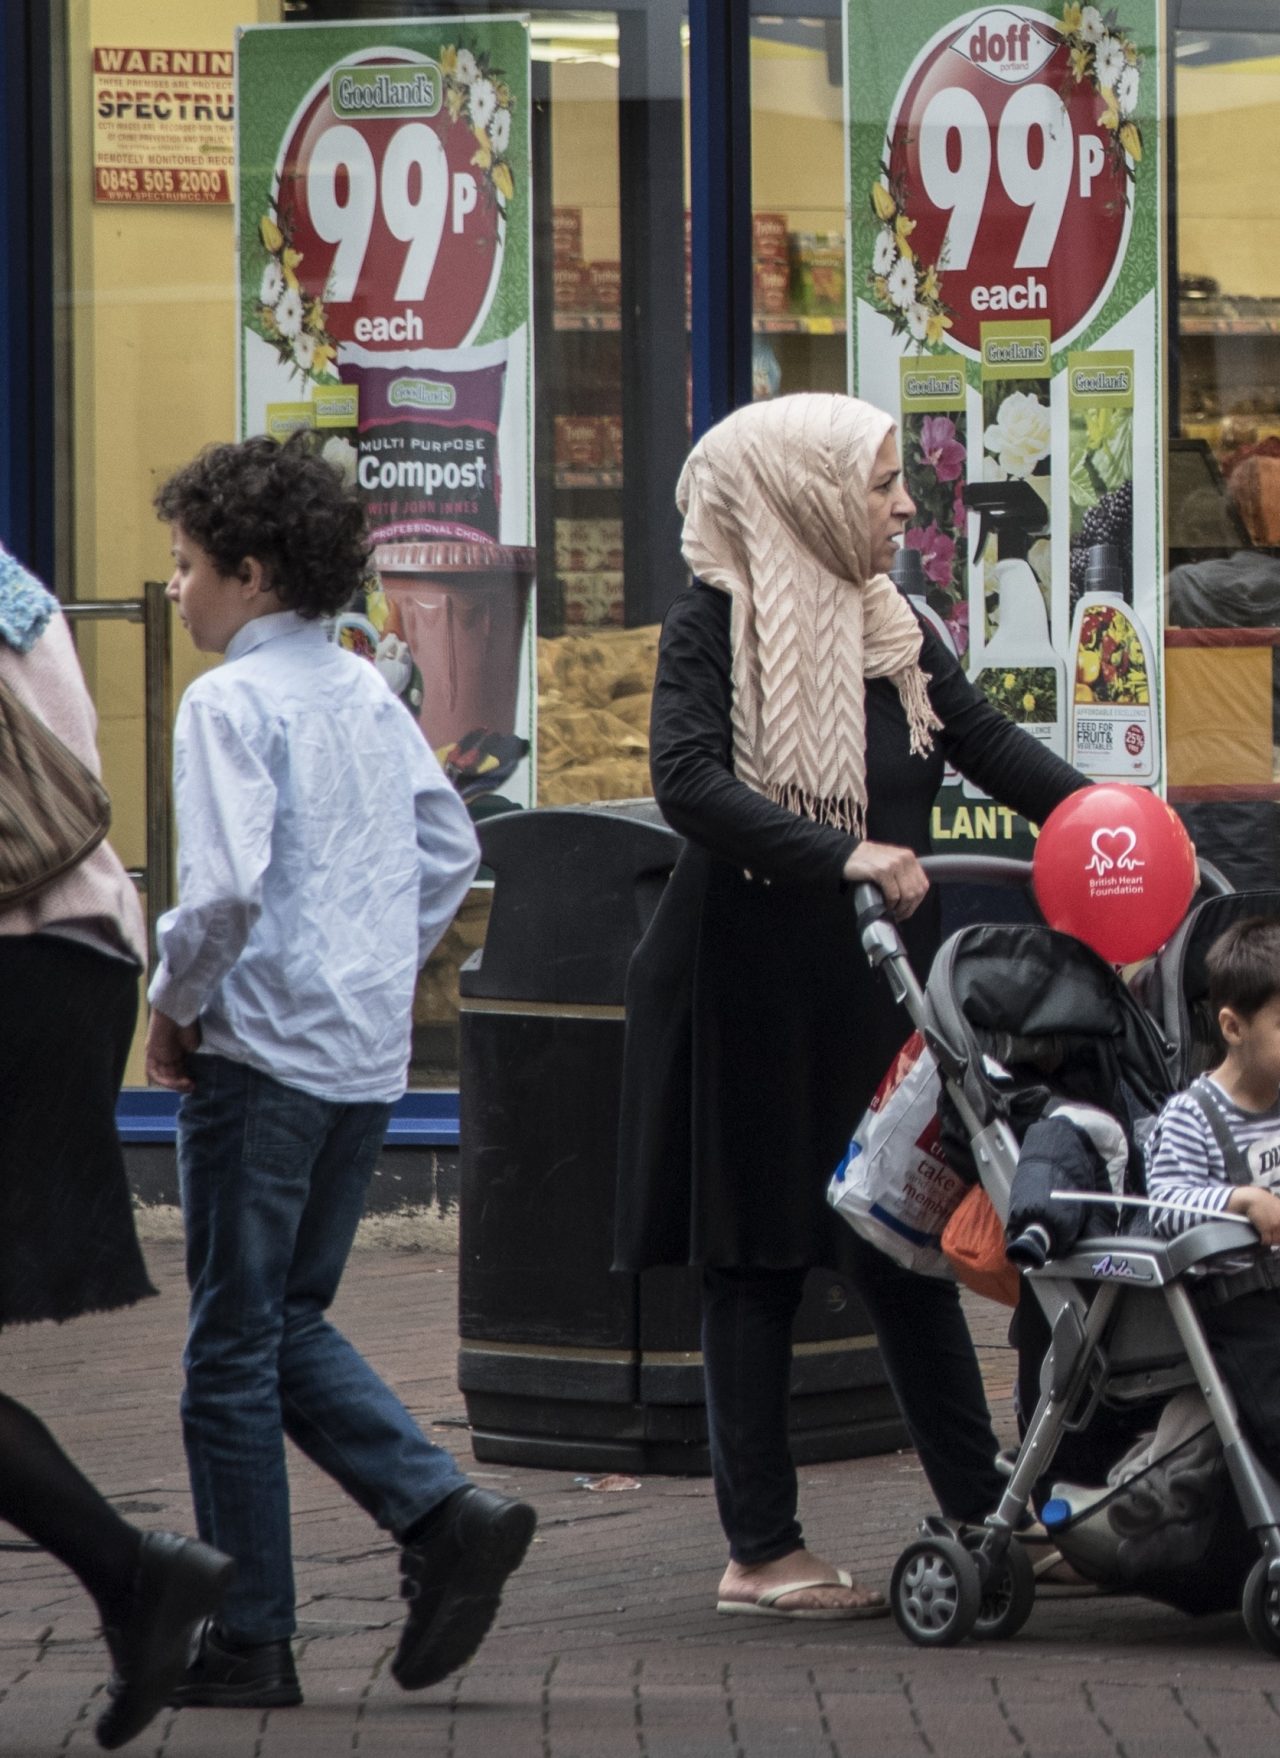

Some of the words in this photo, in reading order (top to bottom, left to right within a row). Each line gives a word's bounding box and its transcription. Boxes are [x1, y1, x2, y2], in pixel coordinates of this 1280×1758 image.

[970, 24, 1030, 63] doff
[99, 50, 233, 74] WARNIN
[193, 81, 233, 89] PROTECT
[98, 90, 234, 121] SPECTRU
[98, 154, 144, 164] REMOTELY
[149, 155, 205, 165] MONITORED
[208, 156, 234, 166] RECO
[100, 169, 138, 190] 0845
[143, 171, 174, 192] 505
[180, 171, 221, 193] 2000
[970, 276, 1048, 311] each
[354, 309, 424, 341] each
[360, 437, 404, 451] MULTI
[410, 437, 486, 452] PURPOSE
[359, 455, 486, 495] Compost
[368, 501, 398, 514] WITH
[373, 524, 454, 540] PROFESSIONAL
[1077, 722, 1096, 731] FEED
[1099, 722, 1113, 732] FOR
[931, 806, 1018, 840] LANT
[1088, 877, 1118, 888] British
[1119, 876, 1143, 885] Heart
[1090, 885, 1144, 897] Foundation
[917, 1160, 956, 1191] take
